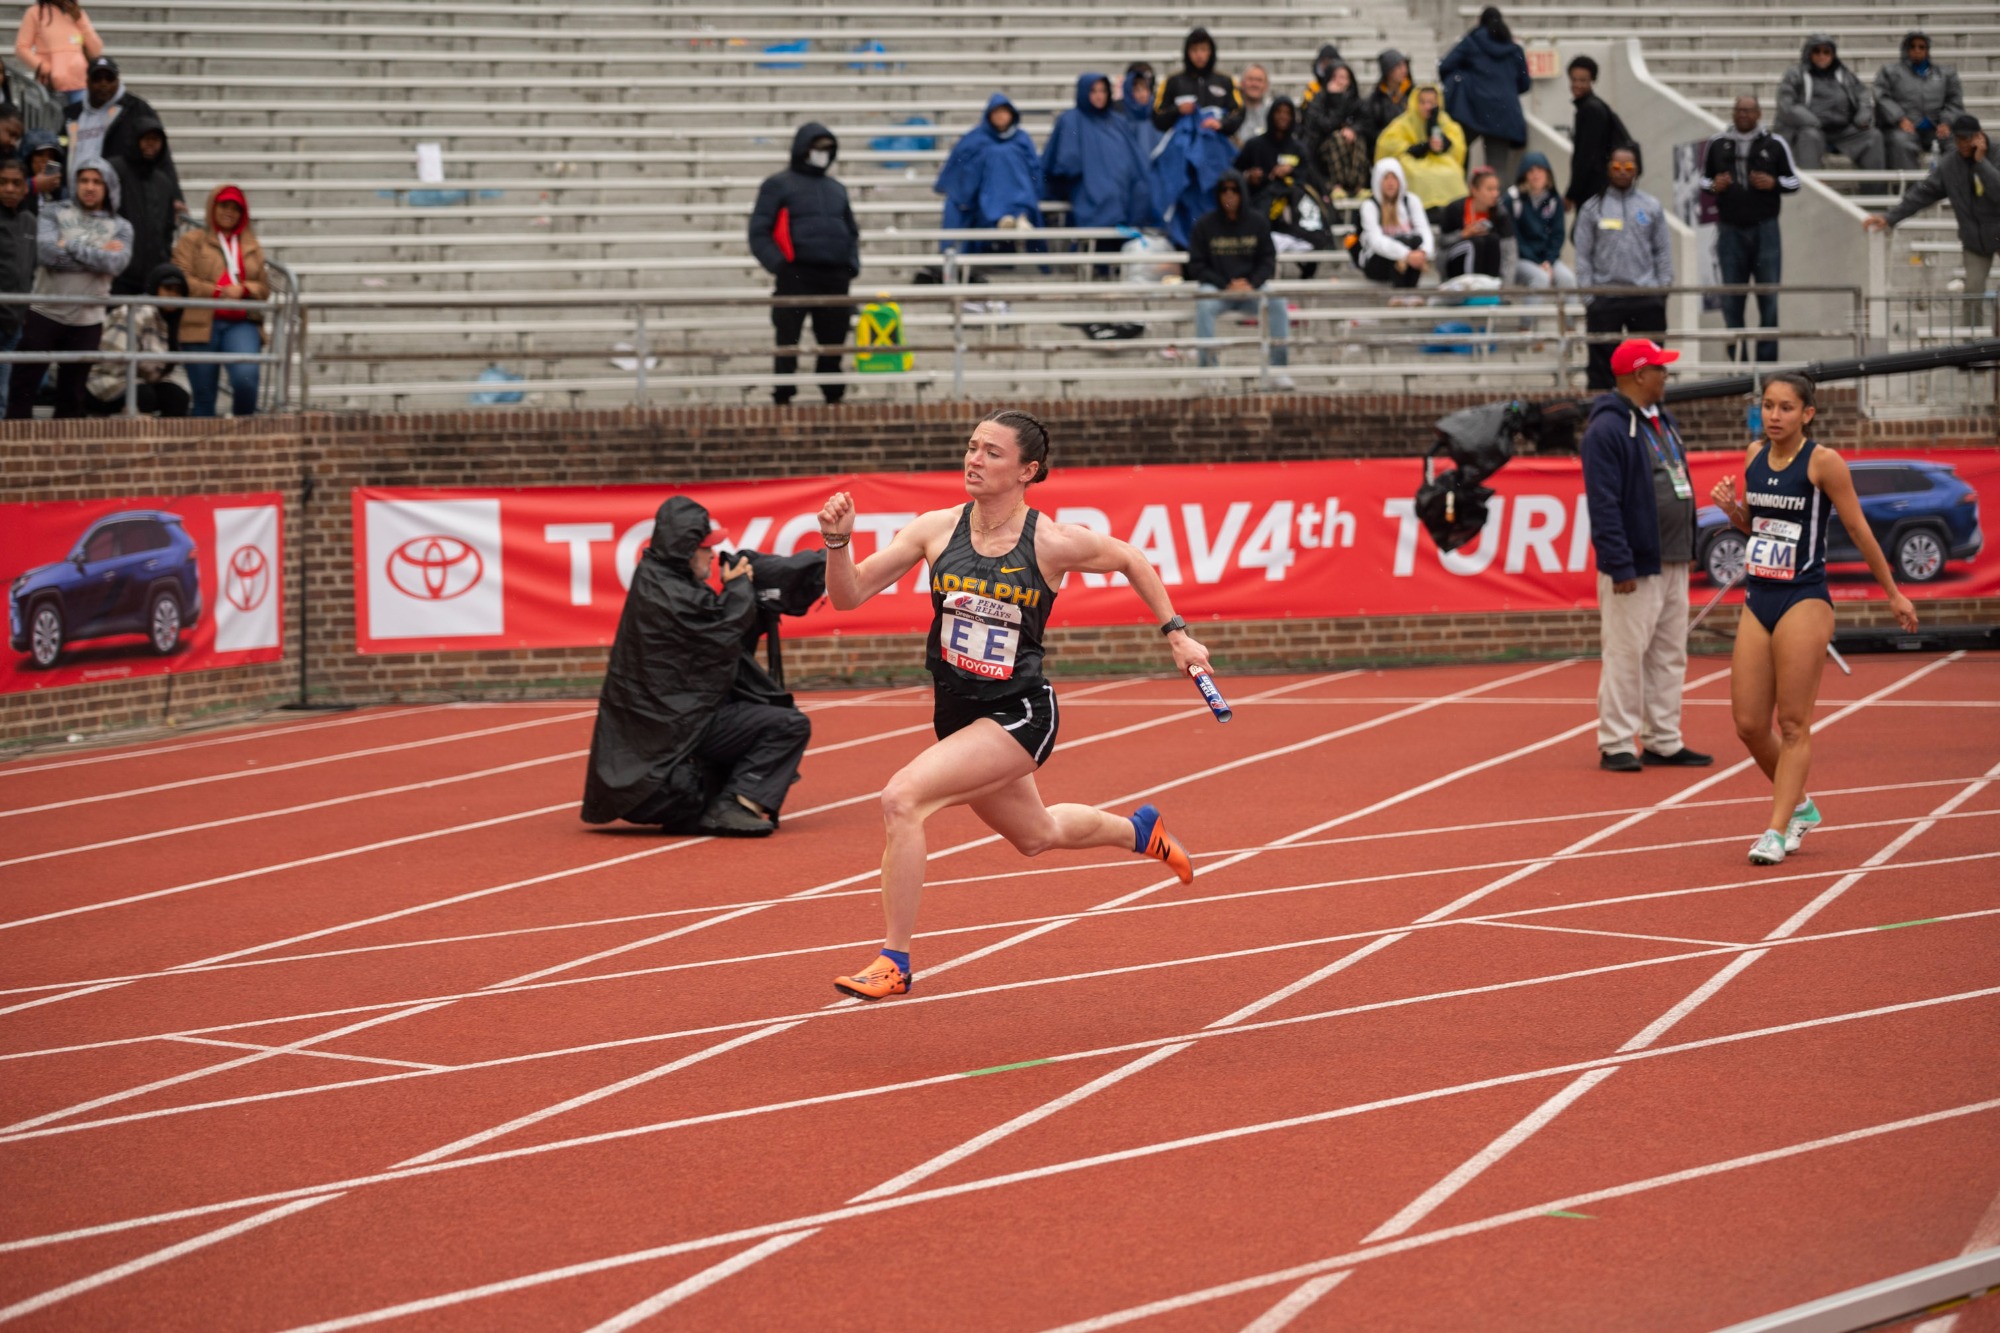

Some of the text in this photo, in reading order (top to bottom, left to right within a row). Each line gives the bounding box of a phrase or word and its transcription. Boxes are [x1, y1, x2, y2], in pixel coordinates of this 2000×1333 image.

[1746, 491, 1806, 511] MONMOUTH
[1756, 566, 1789, 578] TOYOTA
[932, 572, 1040, 608] ADELPHI
[974, 605, 1012, 619] RELAYS
[977, 599, 1004, 611] PENN
[955, 610, 975, 620] Dream
[959, 657, 1004, 677] TOYOTA
